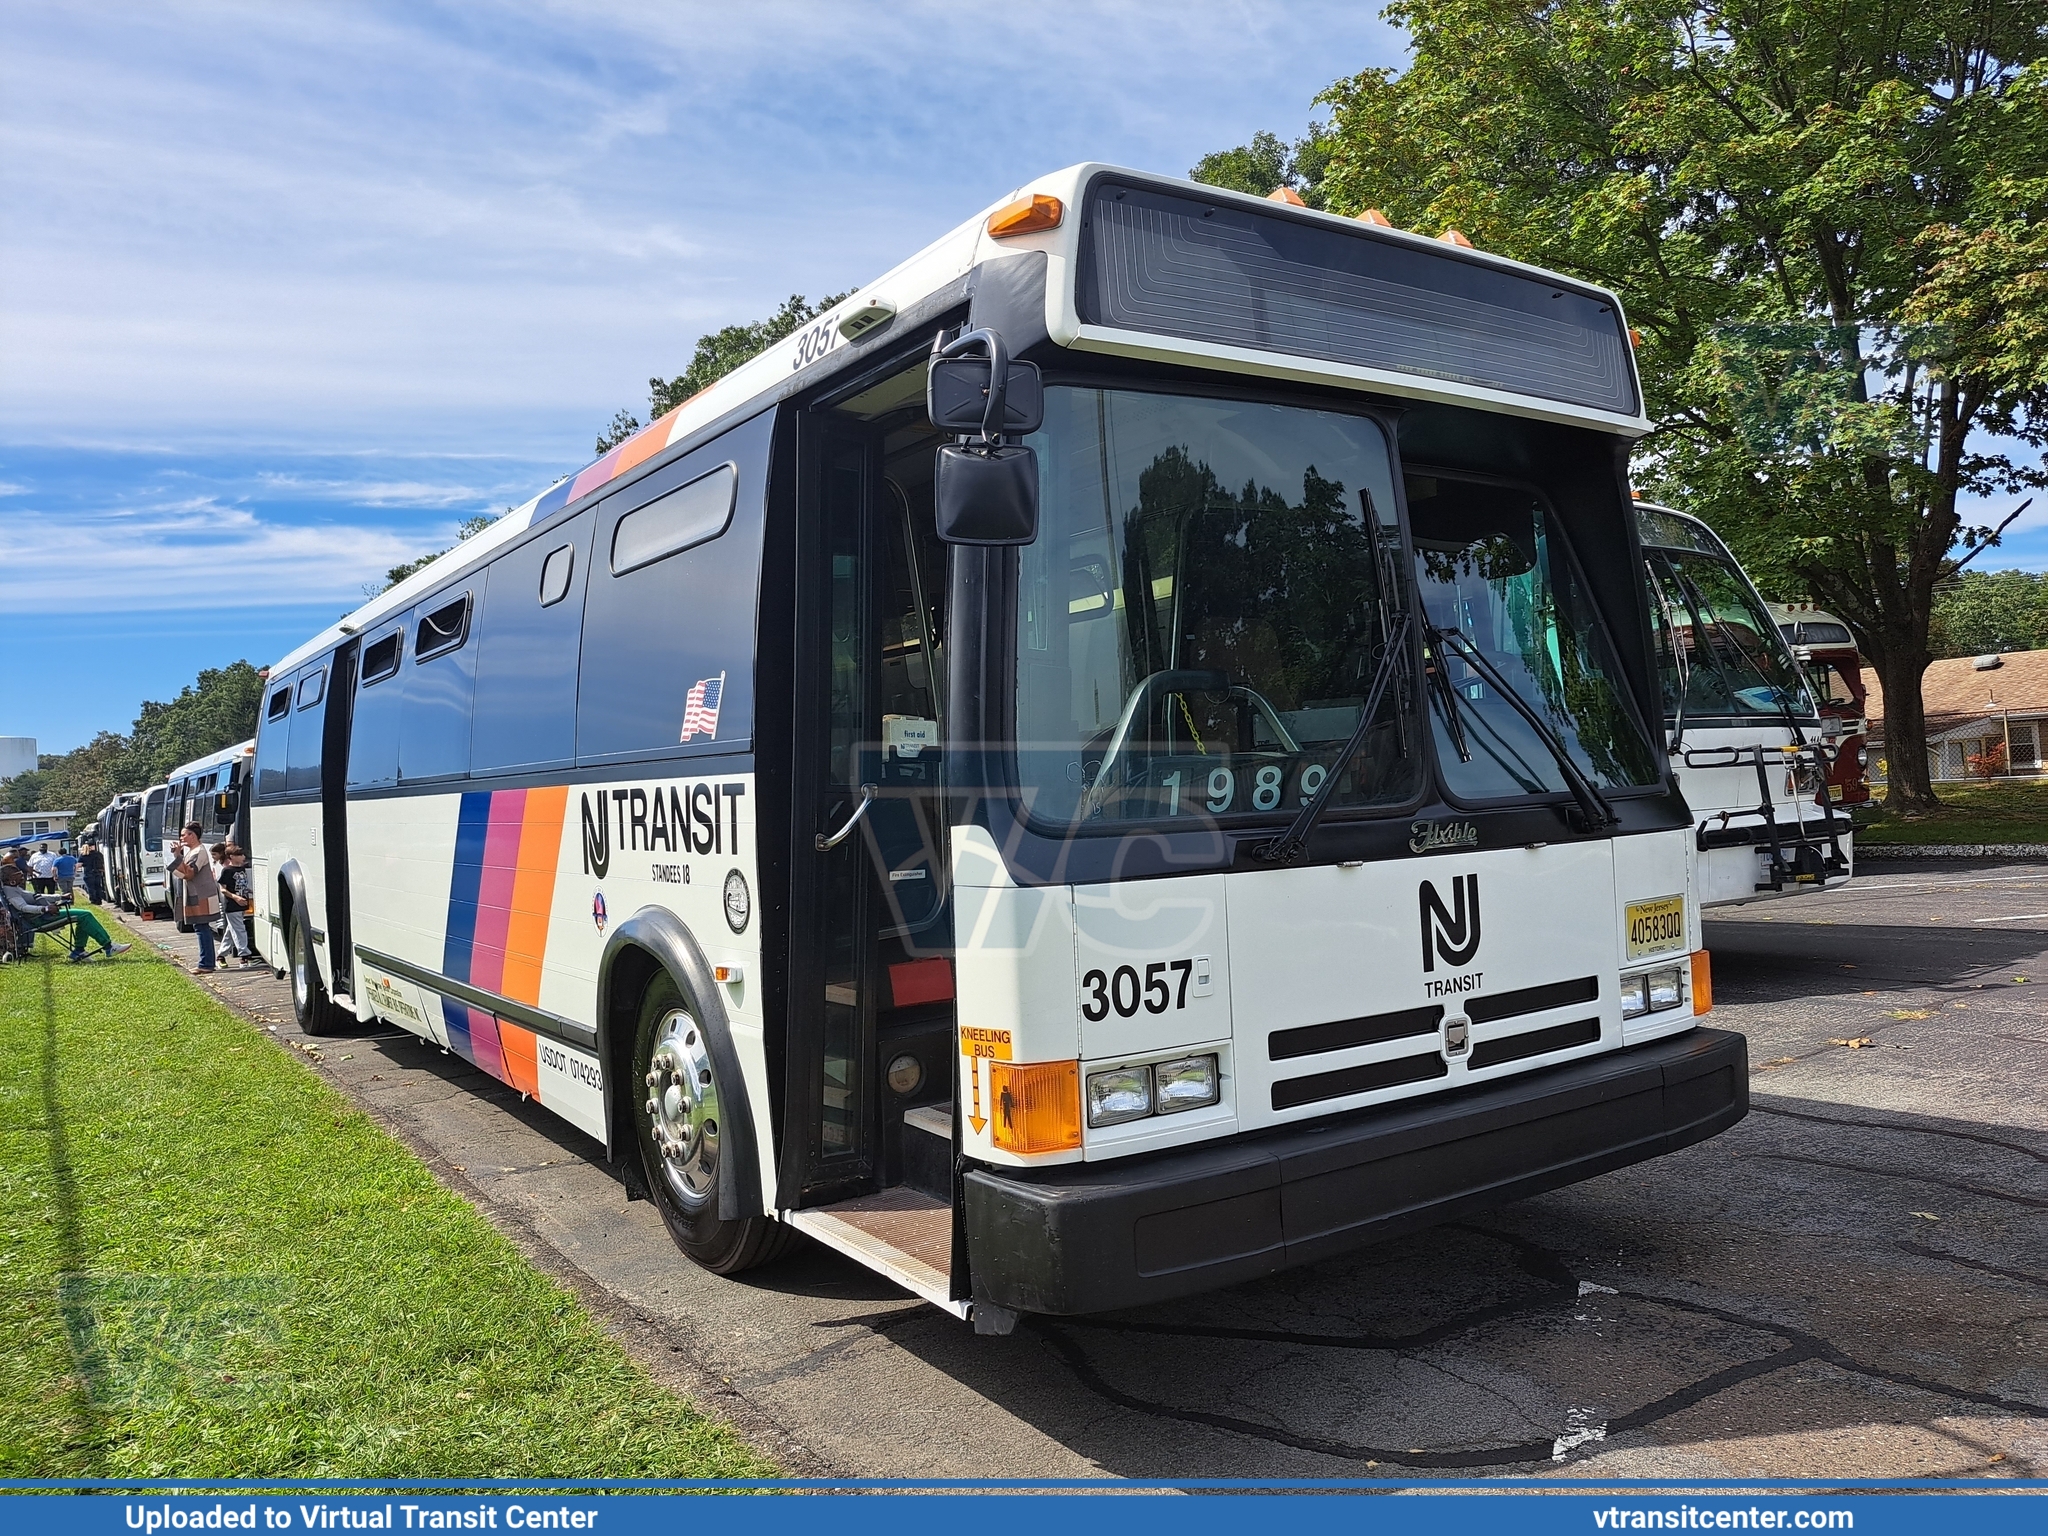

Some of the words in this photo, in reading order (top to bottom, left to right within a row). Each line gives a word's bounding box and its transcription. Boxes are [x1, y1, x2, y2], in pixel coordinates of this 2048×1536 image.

[793, 313, 840, 371] 3057
[904, 730, 916, 738] first
[1162, 764, 1327, 816] 1989
[581, 789, 610, 880] NJ
[612, 782, 746, 856] TRANSIT
[651, 863, 681, 884] STANDEES
[682, 864, 691, 885] 18
[1418, 873, 1482, 973] NJ
[1640, 904, 1653, 914] New
[1653, 903, 1669, 914] Jersey
[1631, 911, 1681, 946] 40583QQ
[1081, 958, 1193, 1022] 3057
[1424, 972, 1484, 999] TRANSIT
[960, 1026, 1011, 1044] KNEELING
[974, 1043, 996, 1058] BUS
[538, 1042, 568, 1075] USDOT
[569, 1057, 603, 1092] 074293
